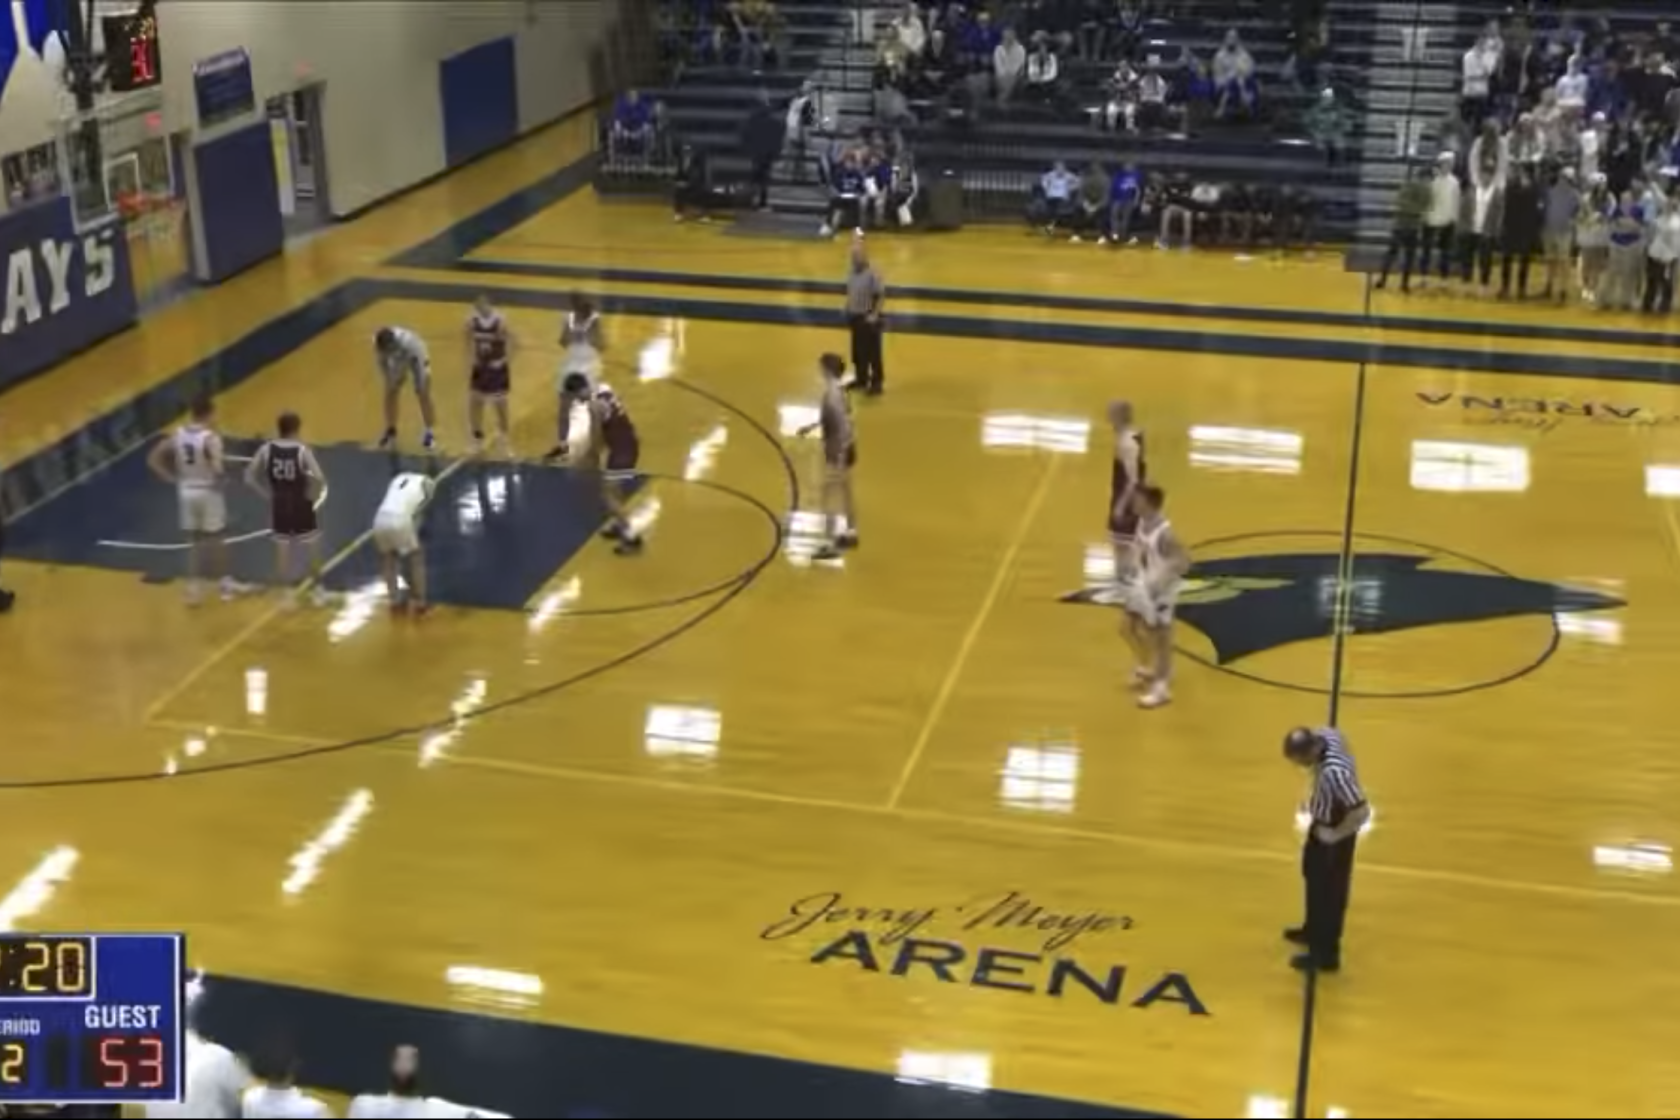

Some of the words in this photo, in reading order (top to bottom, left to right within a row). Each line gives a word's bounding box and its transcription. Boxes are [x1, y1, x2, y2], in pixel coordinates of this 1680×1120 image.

[272, 458, 296, 481] 20
[759, 892, 936, 945] Jerry
[810, 929, 1211, 1017] ARENA
